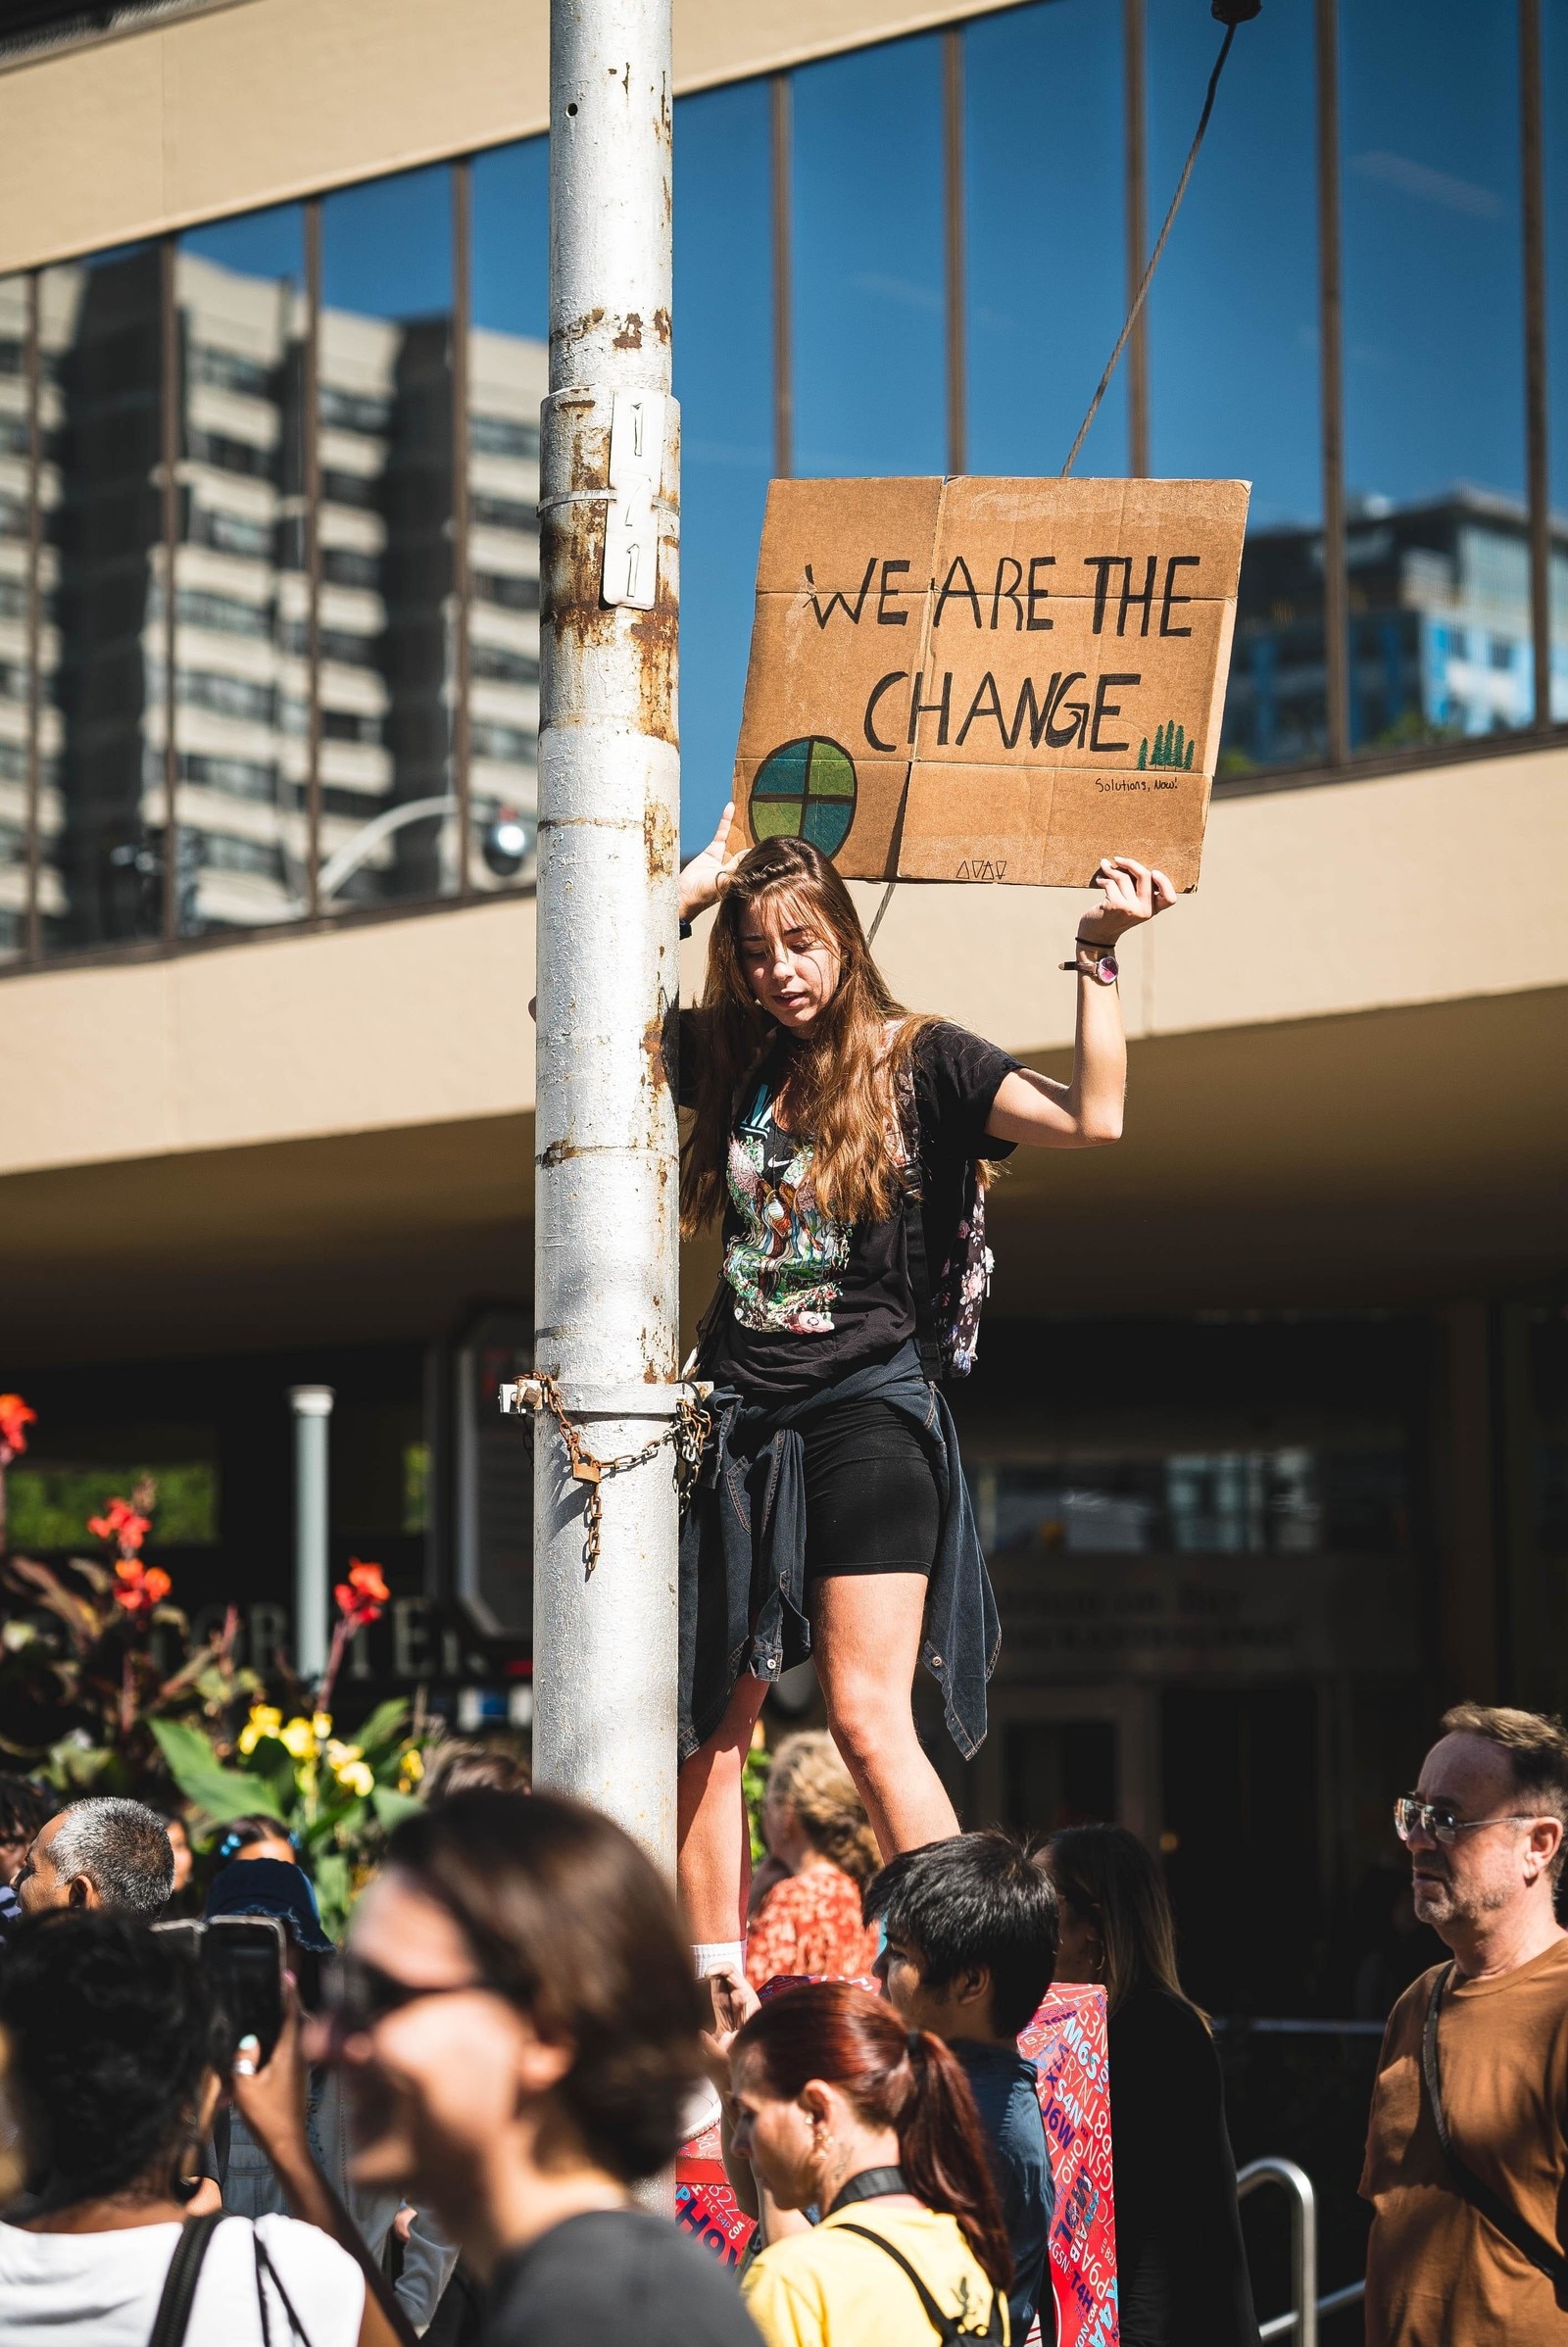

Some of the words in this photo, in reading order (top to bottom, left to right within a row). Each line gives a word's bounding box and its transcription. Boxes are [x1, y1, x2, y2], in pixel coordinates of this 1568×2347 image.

[616, 402, 654, 598] 171
[804, 558, 911, 630] WE
[932, 555, 1056, 631] ARE
[1084, 555, 1200, 638] THE
[863, 670, 1141, 753] CHANGE
[1095, 778, 1151, 793] Solutions,
[1153, 776, 1178, 790] Now!
[1062, 2017, 1101, 2080] M6S
[1054, 2078, 1084, 2128] S4N
[1063, 2055, 1093, 2108] R7N
[1042, 2097, 1075, 2150] J6W
[1052, 2243, 1070, 2274] G5N
[1070, 2269, 1095, 2313] T4H
